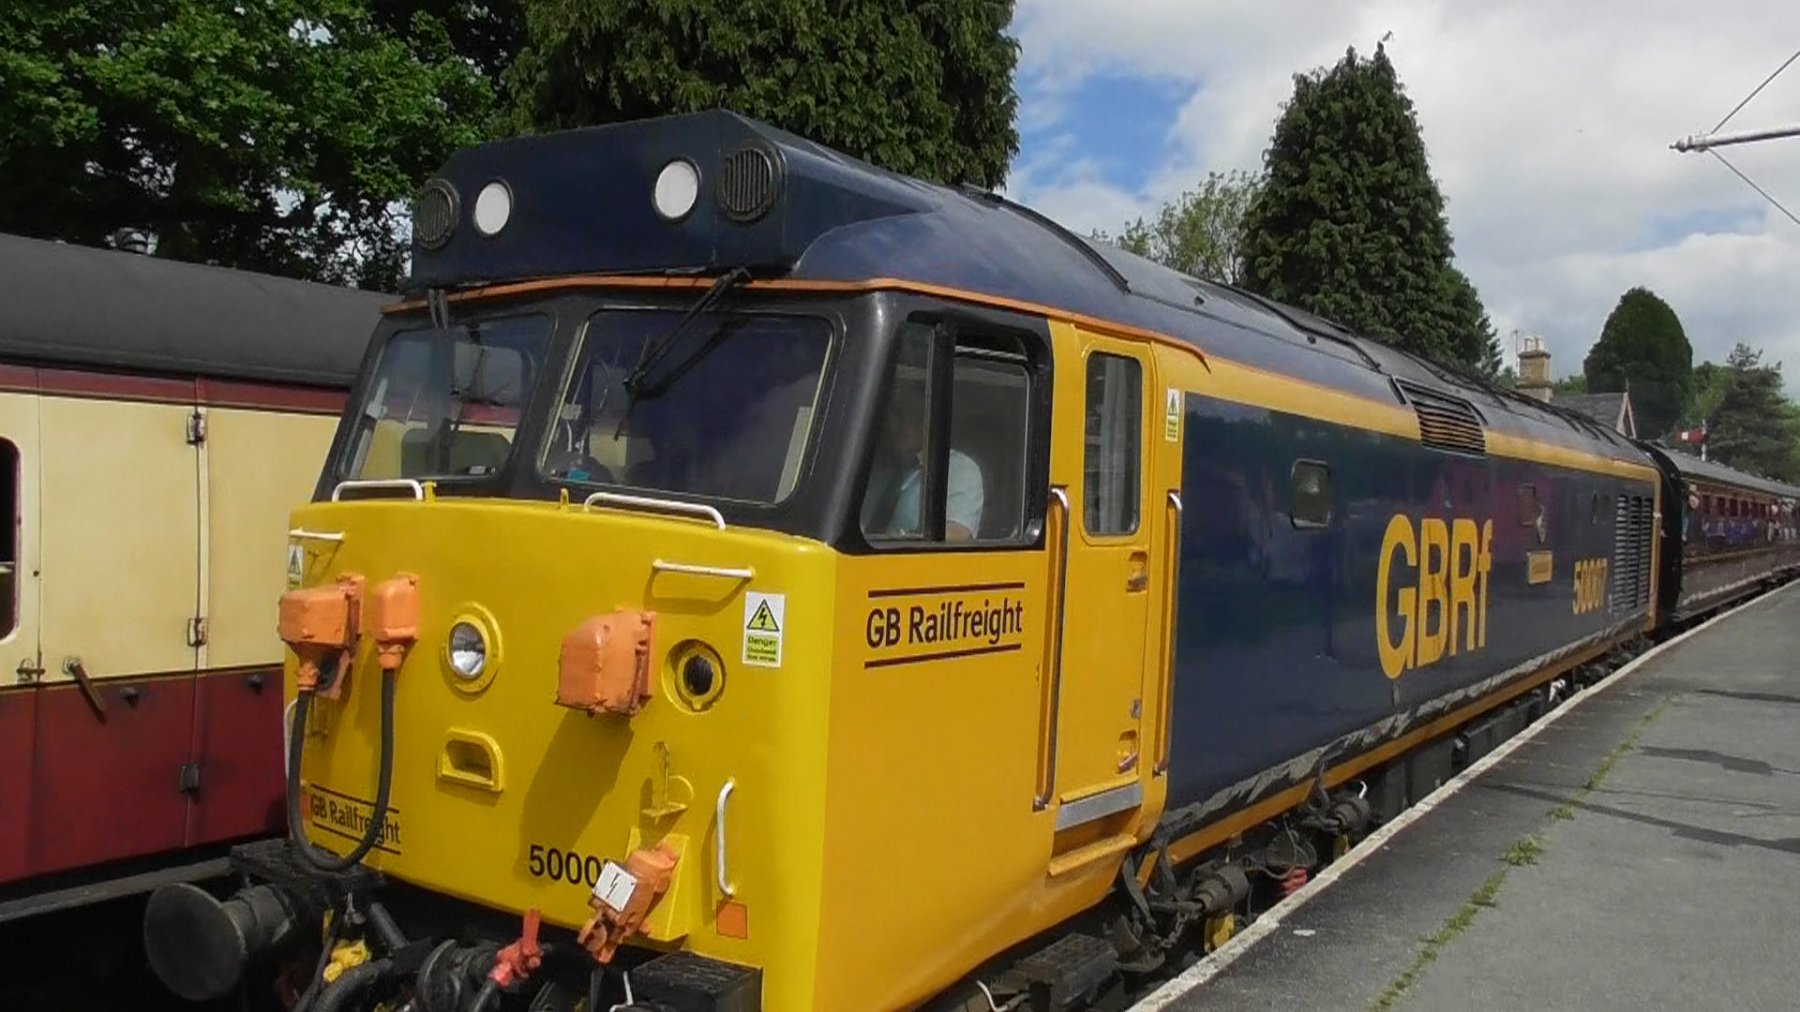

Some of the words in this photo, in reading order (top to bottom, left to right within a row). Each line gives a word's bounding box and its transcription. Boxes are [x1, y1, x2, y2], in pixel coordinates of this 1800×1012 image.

[1376, 513, 1493, 680] GBRf
[866, 607, 901, 649] GB
[908, 597, 1023, 645] Railfreight
[312, 794, 328, 819] GB
[529, 844, 626, 889] 5000
